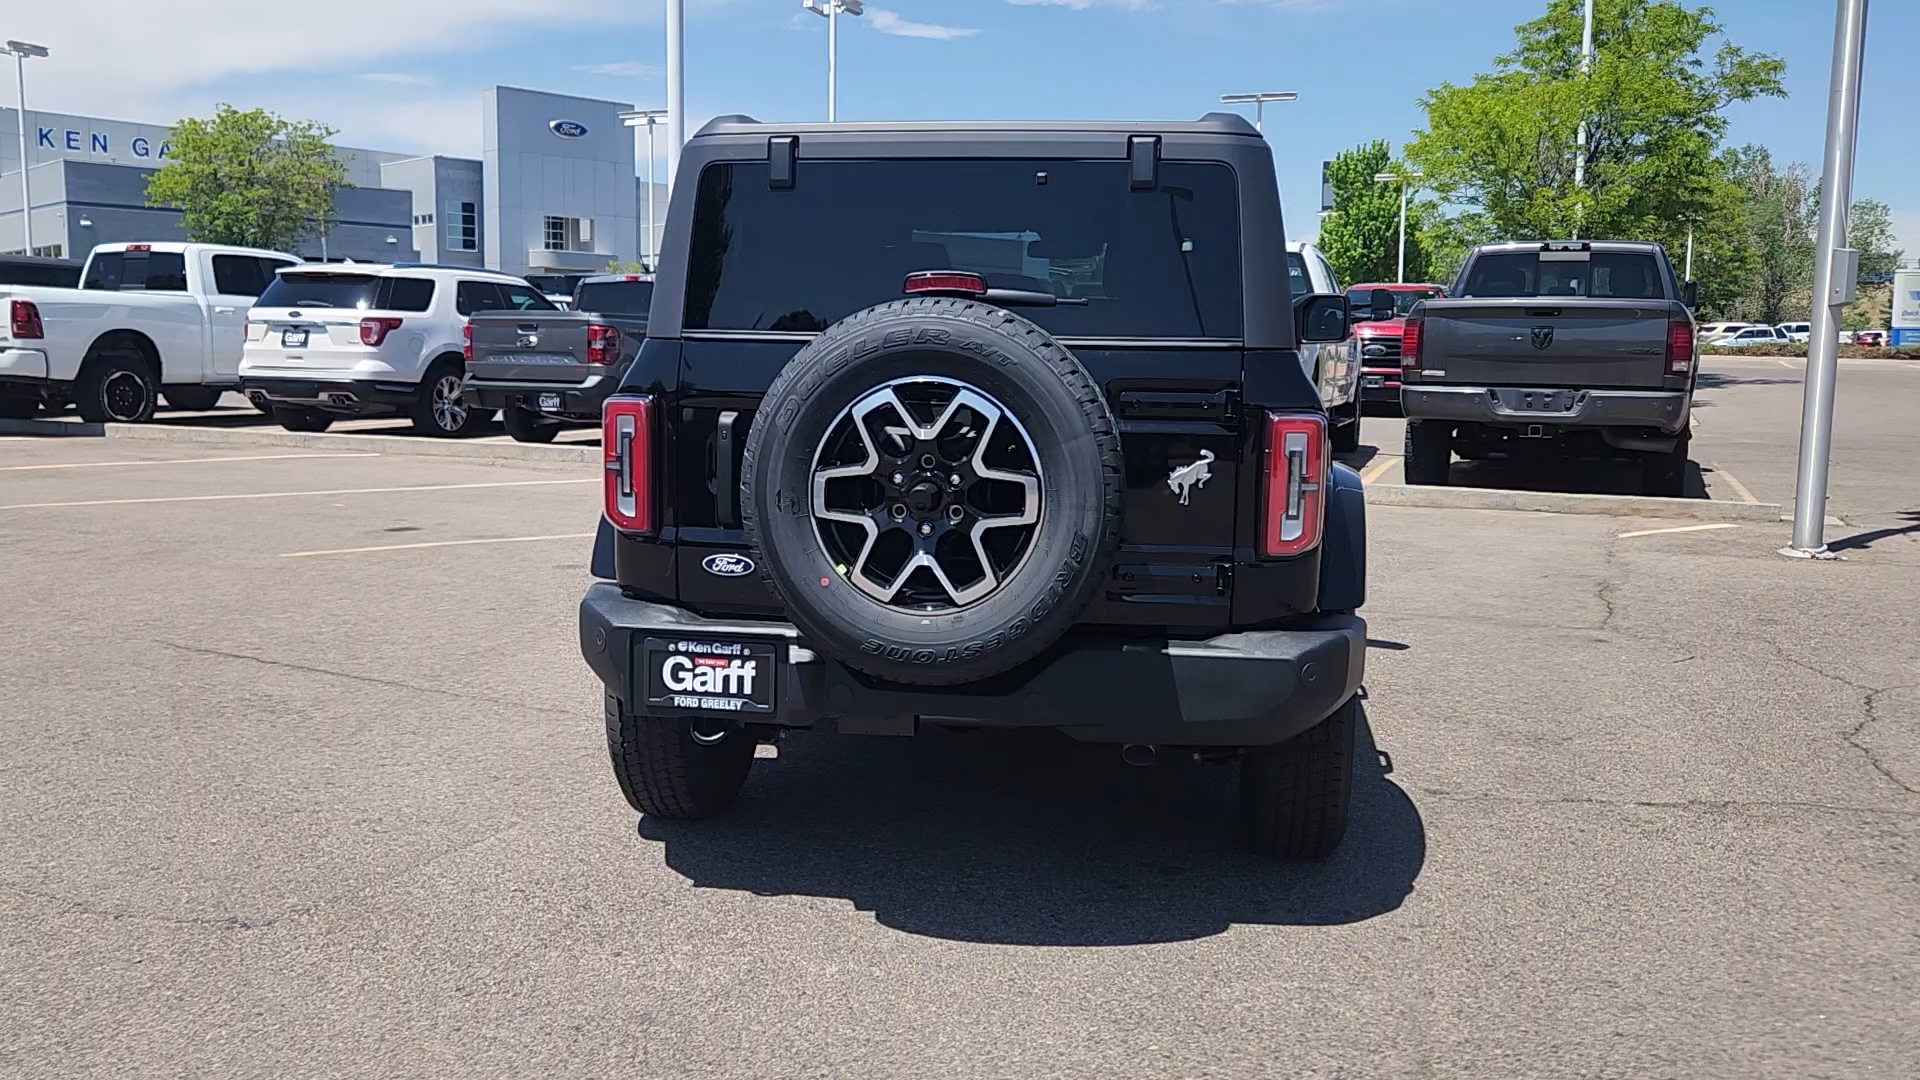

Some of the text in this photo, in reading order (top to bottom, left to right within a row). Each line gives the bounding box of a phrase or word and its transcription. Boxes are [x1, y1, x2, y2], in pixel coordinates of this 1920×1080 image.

[38, 127, 108, 153] KEN
[775, 327, 1017, 435] DUELER A/T
[712, 556, 745, 573] Ford
[860, 530, 1089, 664] BRIDGESTONE
[688, 642, 741, 655] Ken Garff
[662, 655, 756, 695] Garff
[674, 696, 742, 711] FORD GREELEY
